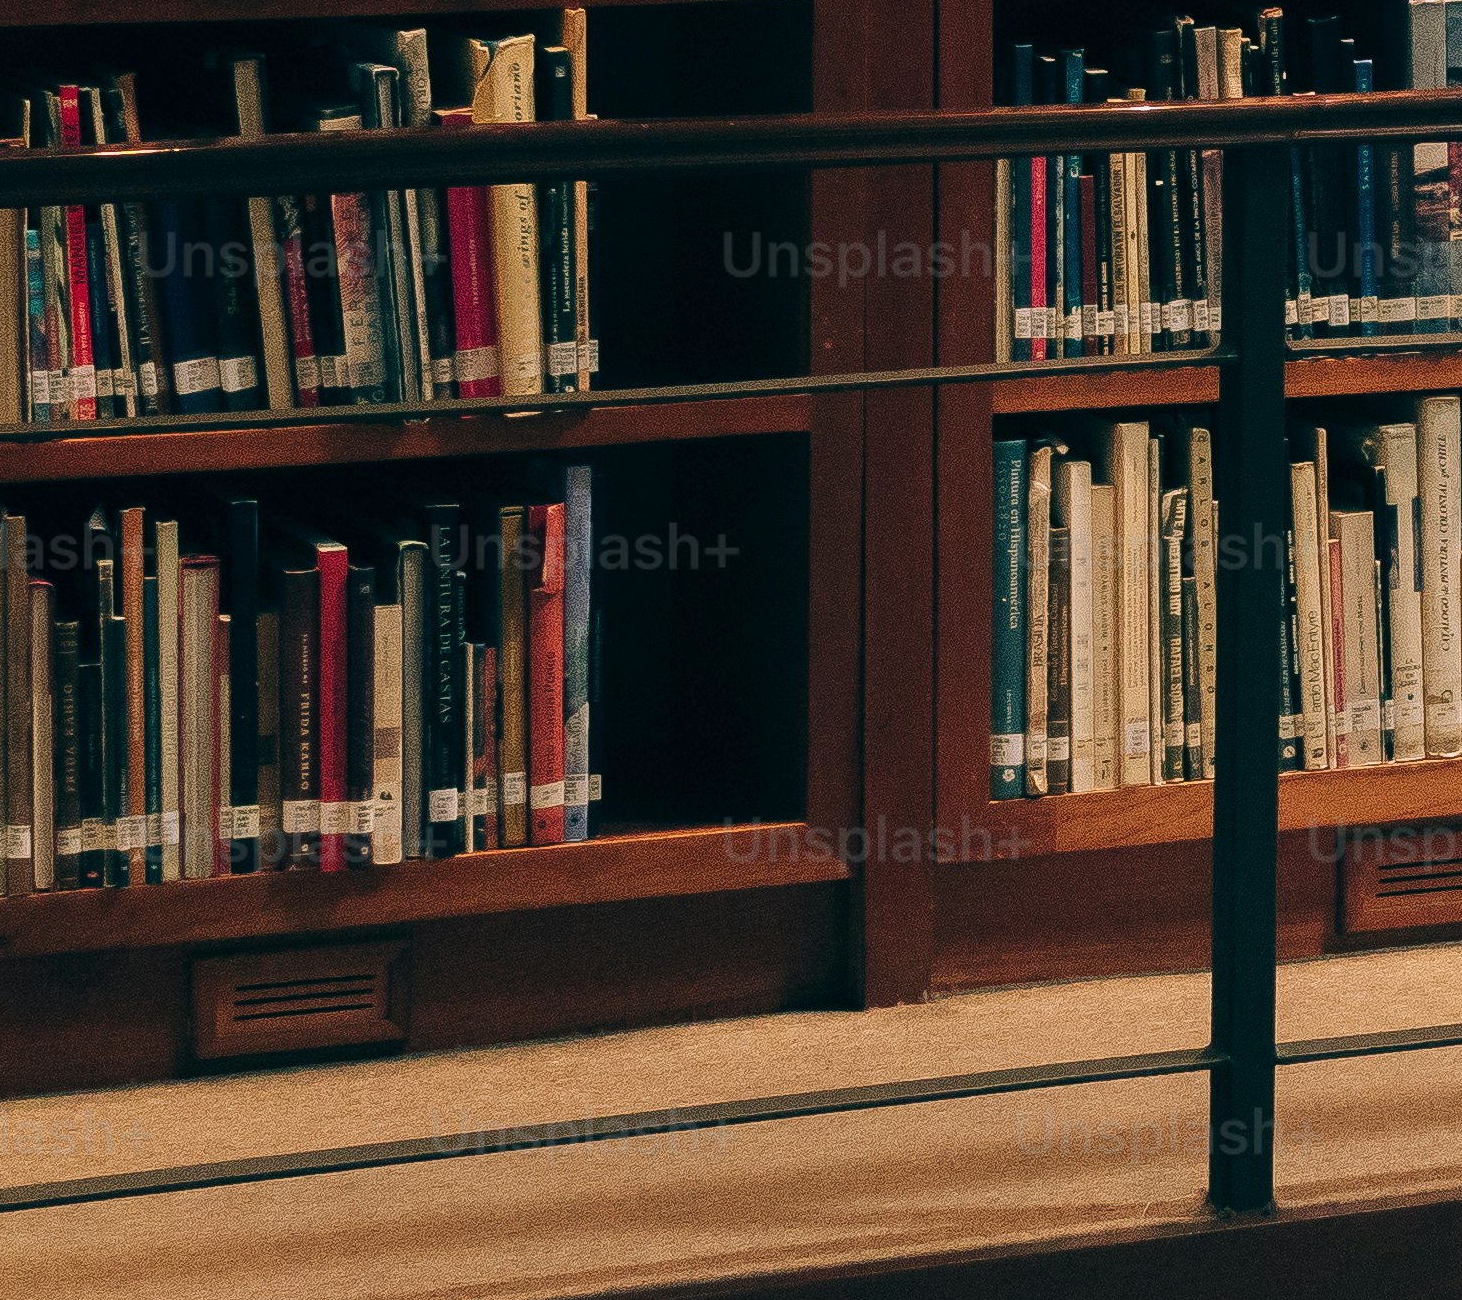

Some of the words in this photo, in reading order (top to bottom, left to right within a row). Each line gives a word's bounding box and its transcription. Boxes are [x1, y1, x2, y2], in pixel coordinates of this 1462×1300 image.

[1009, 459, 1022, 502] Pintura
[1010, 504, 1020, 523] en
[1007, 527, 1023, 630] Hispanoamérica
